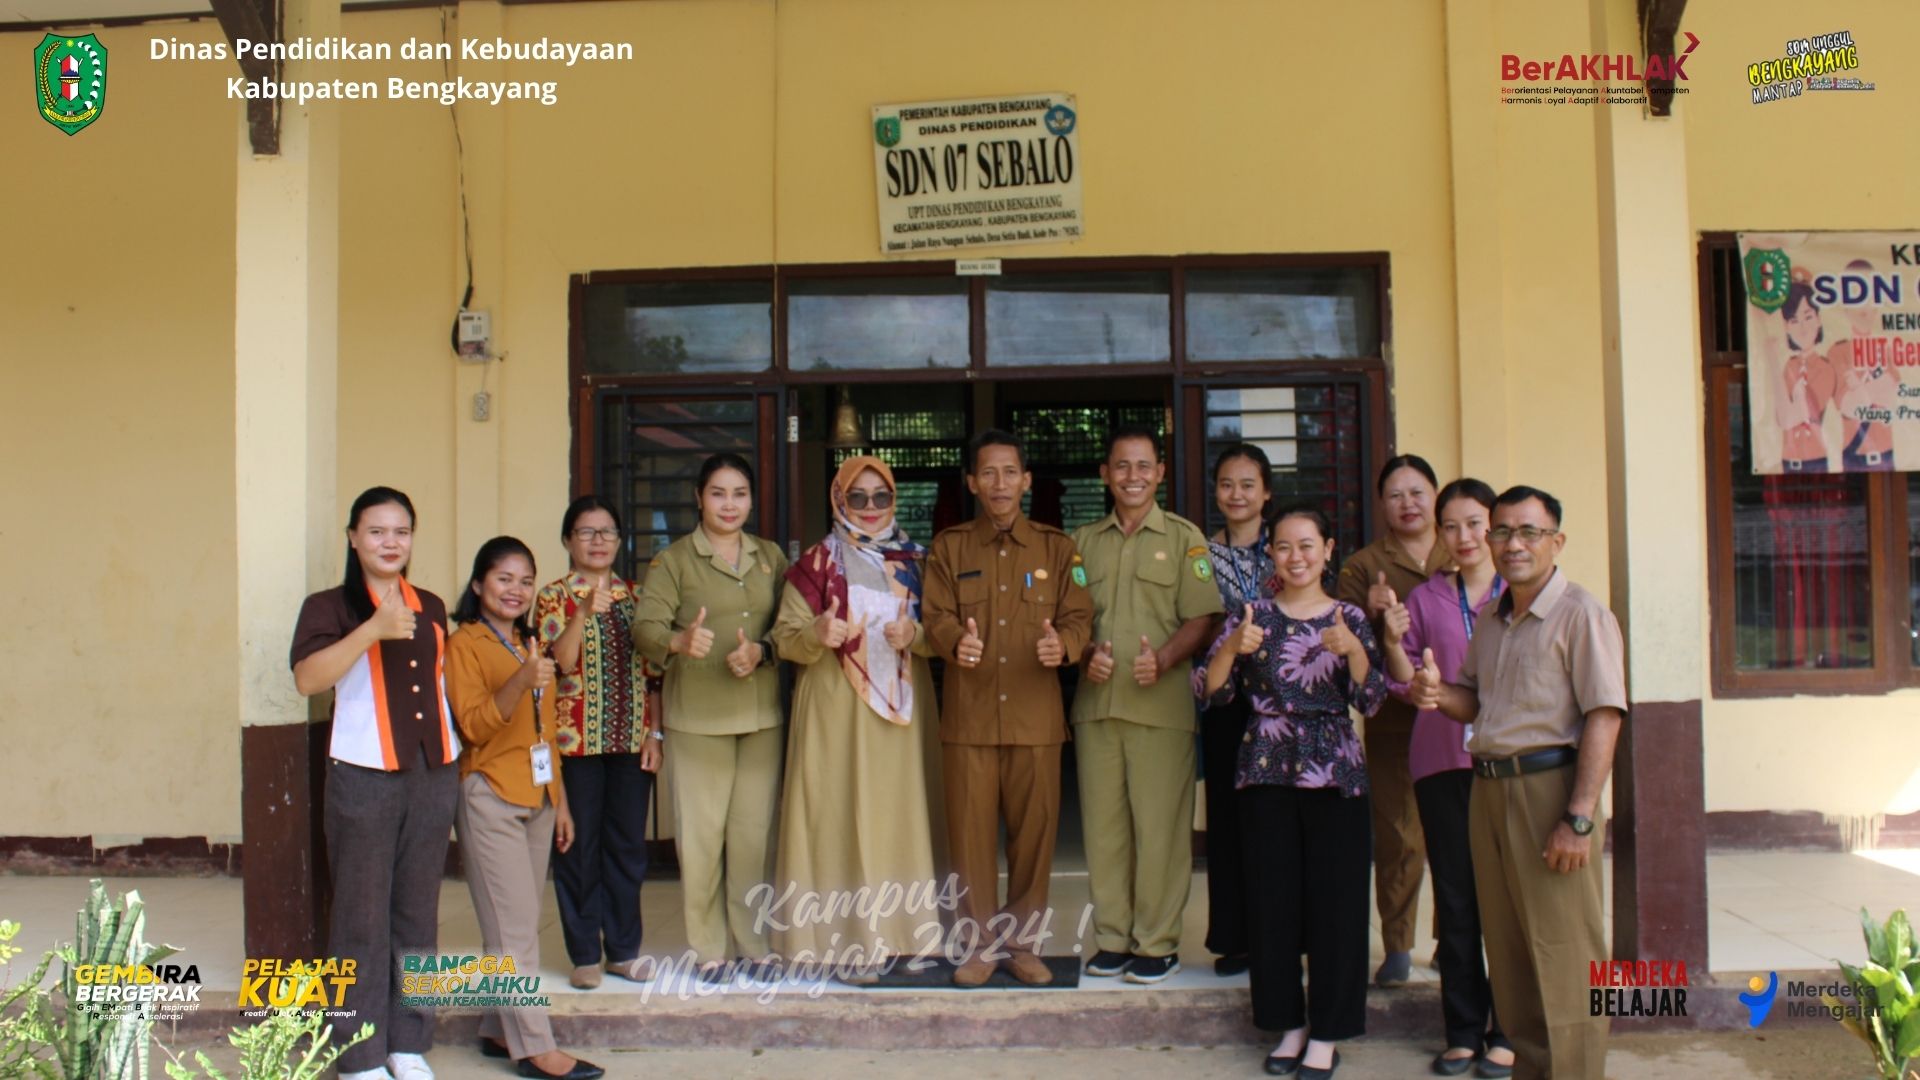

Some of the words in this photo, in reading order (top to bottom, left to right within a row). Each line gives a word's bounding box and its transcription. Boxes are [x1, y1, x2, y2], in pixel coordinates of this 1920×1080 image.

[900, 106, 949, 120] PEMERINTAH
[951, 102, 997, 116] KABUPATEN
[999, 98, 1051, 112] BENGKAYANG
[919, 124, 956, 136] DINAS
[960, 117, 1037, 132] PENDIDIKAN
[885, 147, 938, 198] SDN
[943, 143, 968, 193] 07
[976, 135, 1073, 190] SEBALO
[907, 205, 925, 219] UPT
[926, 202, 952, 218] DINAS
[952, 198, 1005, 216] PENDIDIKAN
[1006, 194, 1062, 211] BENGKAYANG
[1030, 210, 1076, 222] BENGKAYANG
[1815, 274, 1900, 305] SDN
[1882, 312, 1920, 330] MEN
[1853, 337, 1888, 367] HUT
[1854, 407, 1891, 423] Yang
